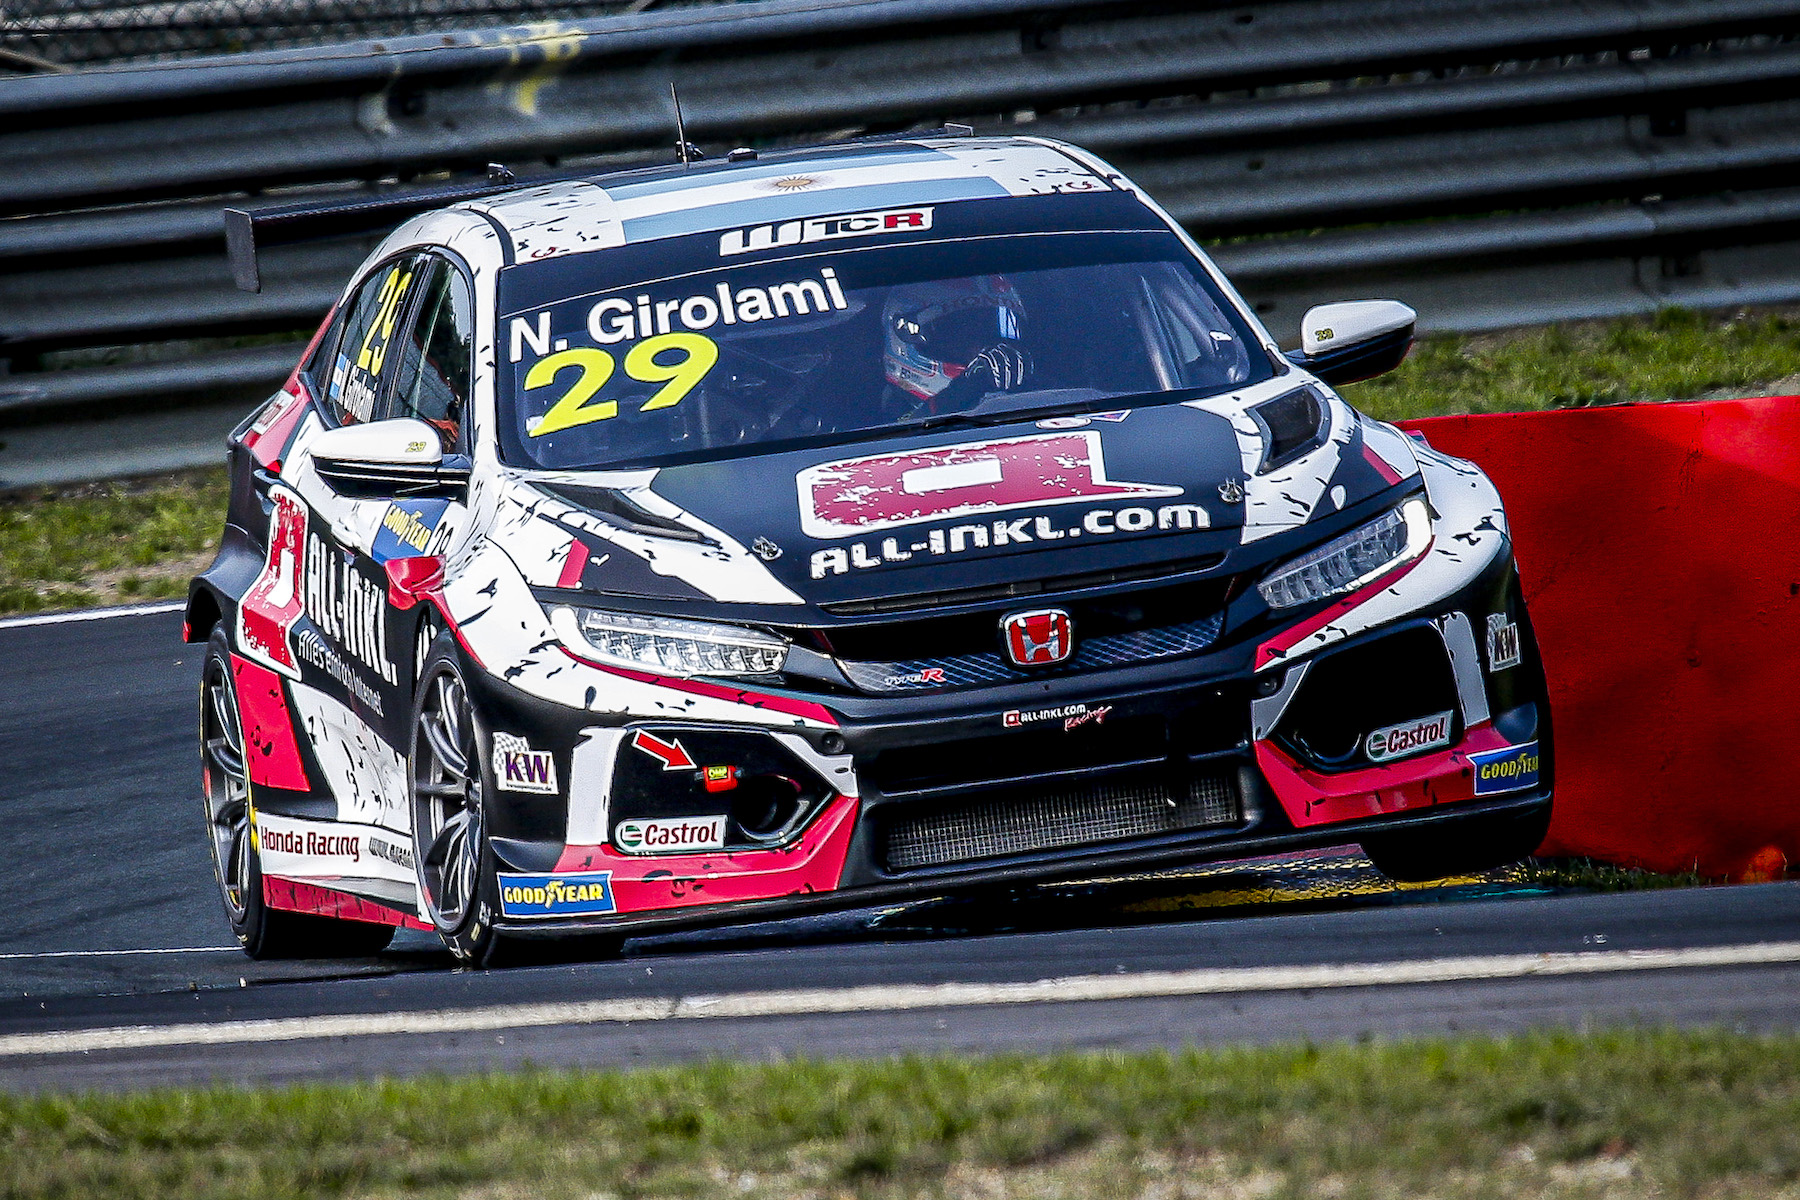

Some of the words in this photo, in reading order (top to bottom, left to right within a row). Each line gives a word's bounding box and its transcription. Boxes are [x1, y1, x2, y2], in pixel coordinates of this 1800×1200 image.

[720, 206, 935, 256] WTCR
[356, 267, 412, 377] 29
[510, 311, 568, 363] N.
[587, 267, 848, 343] Girolami
[523, 332, 719, 437] 29
[383, 504, 432, 553] GOODYEAR
[298, 629, 325, 670] Alles
[1387, 717, 1446, 753] Castrol
[504, 751, 552, 784] KW
[260, 826, 303, 854] Honda
[306, 831, 361, 862] Racing
[643, 820, 719, 846] Castrol
[503, 880, 605, 908] GOODYEAR
